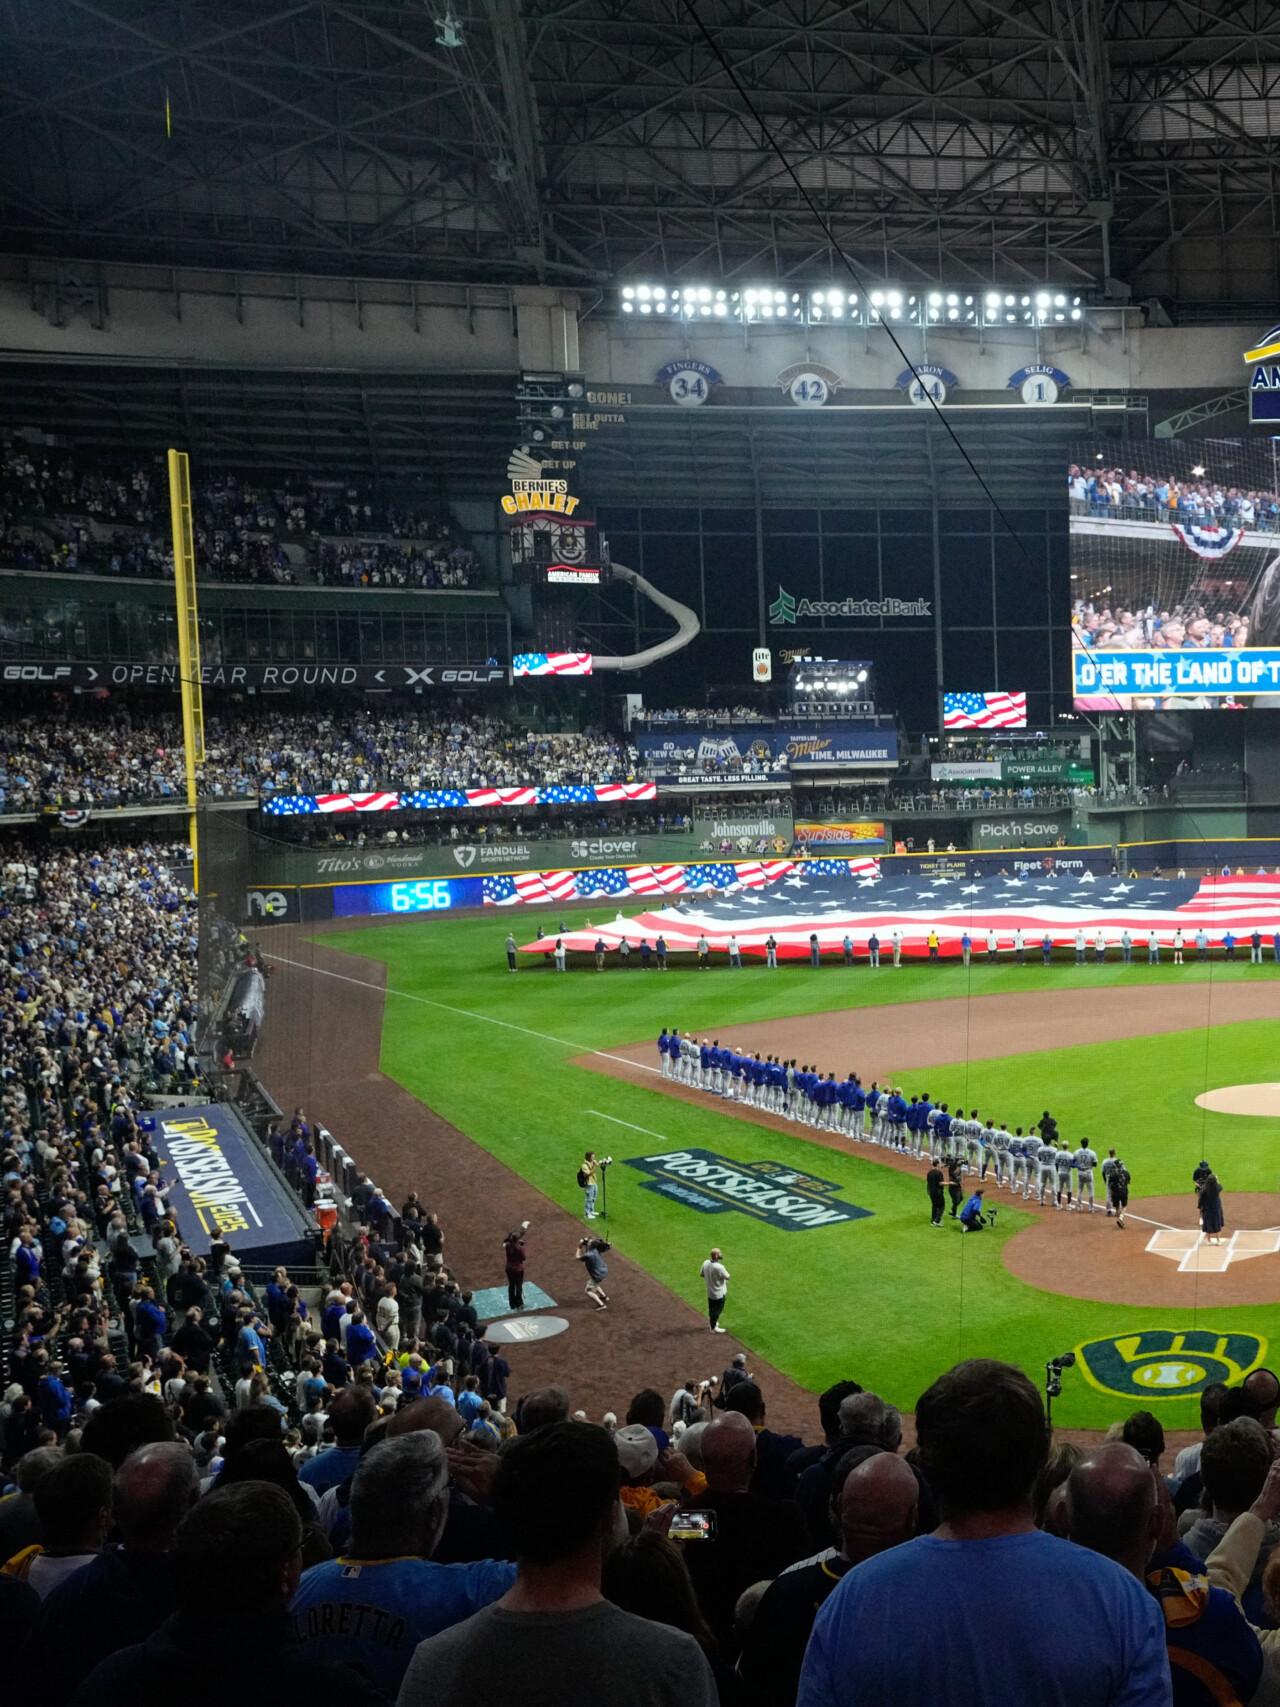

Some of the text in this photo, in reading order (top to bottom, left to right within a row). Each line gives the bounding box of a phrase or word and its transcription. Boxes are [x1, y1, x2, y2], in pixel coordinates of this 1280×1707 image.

[666, 361, 711, 375] FINGERS
[1024, 364, 1054, 376] SELIG
[674, 378, 704, 399] 34
[794, 380, 824, 401] 42
[913, 381, 942, 401] 44
[1036, 382, 1046, 402] 1
[587, 392, 631, 404] GONE!
[551, 440, 586, 450] GET UP
[541, 459, 576, 469] GET UP
[512, 479, 567, 493] BERNIE'S
[501, 492, 579, 516] CHALET
[755, 651, 770, 662] Lite
[3, 666, 72, 680] GOLF
[112, 665, 176, 684] OPEN
[263, 667, 357, 684] ROUND
[441, 670, 504, 682] GOLF
[1081, 662, 1128, 685] O'ER
[1132, 662, 1172, 685] THE
[1177, 661, 1233, 684] LAND
[1237, 661, 1263, 684] OF
[663, 742, 675, 751] GO
[786, 738, 832, 760] Miller
[810, 750, 888, 761] TIME, MILWAUKEE
[1007, 765, 1063, 774] POWER ALLEY
[678, 774, 769, 784] GREAT TASTE. LESS FILLING.
[711, 821, 775, 838] Johnsonville
[798, 826, 851, 842] Surfside
[980, 822, 1059, 837] Pick Save
[480, 845, 530, 856] FANDUEL
[589, 840, 637, 854] clover
[317, 857, 362, 873] Tito's
[501, 854, 530, 862] NETWORK
[1014, 859, 1083, 871] Fleet Farm
[391, 880, 451, 911] 6:56
[164, 1128, 249, 1209] POSTSEASON
[644, 1151, 850, 1226] POSTSEASON
[210, 1203, 249, 1233] 2025
[294, 1601, 406, 1650] LORETTA
